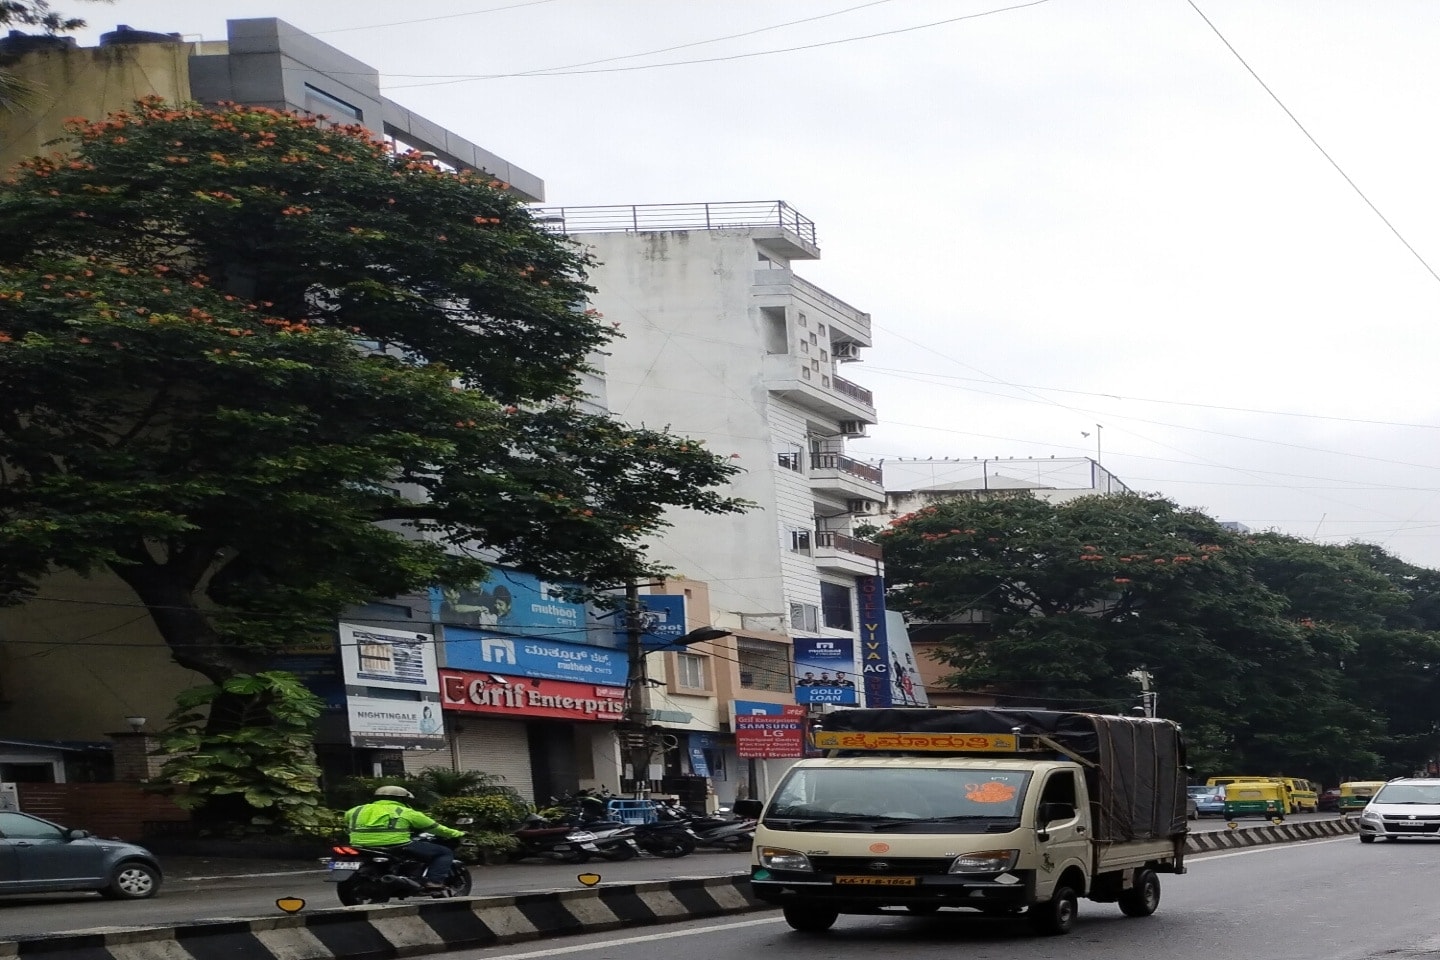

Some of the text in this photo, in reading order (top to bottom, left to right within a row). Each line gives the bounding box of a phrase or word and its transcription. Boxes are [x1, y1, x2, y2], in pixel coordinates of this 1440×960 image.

[531, 604, 577, 619] muthoot
[865, 623, 881, 660] VIVA
[557, 660, 593, 673] muthoot
[863, 663, 887, 673] AC
[469, 679, 526, 708] Grif
[357, 711, 418, 721] NIGHTINGALE
[763, 730, 785, 738] LG
